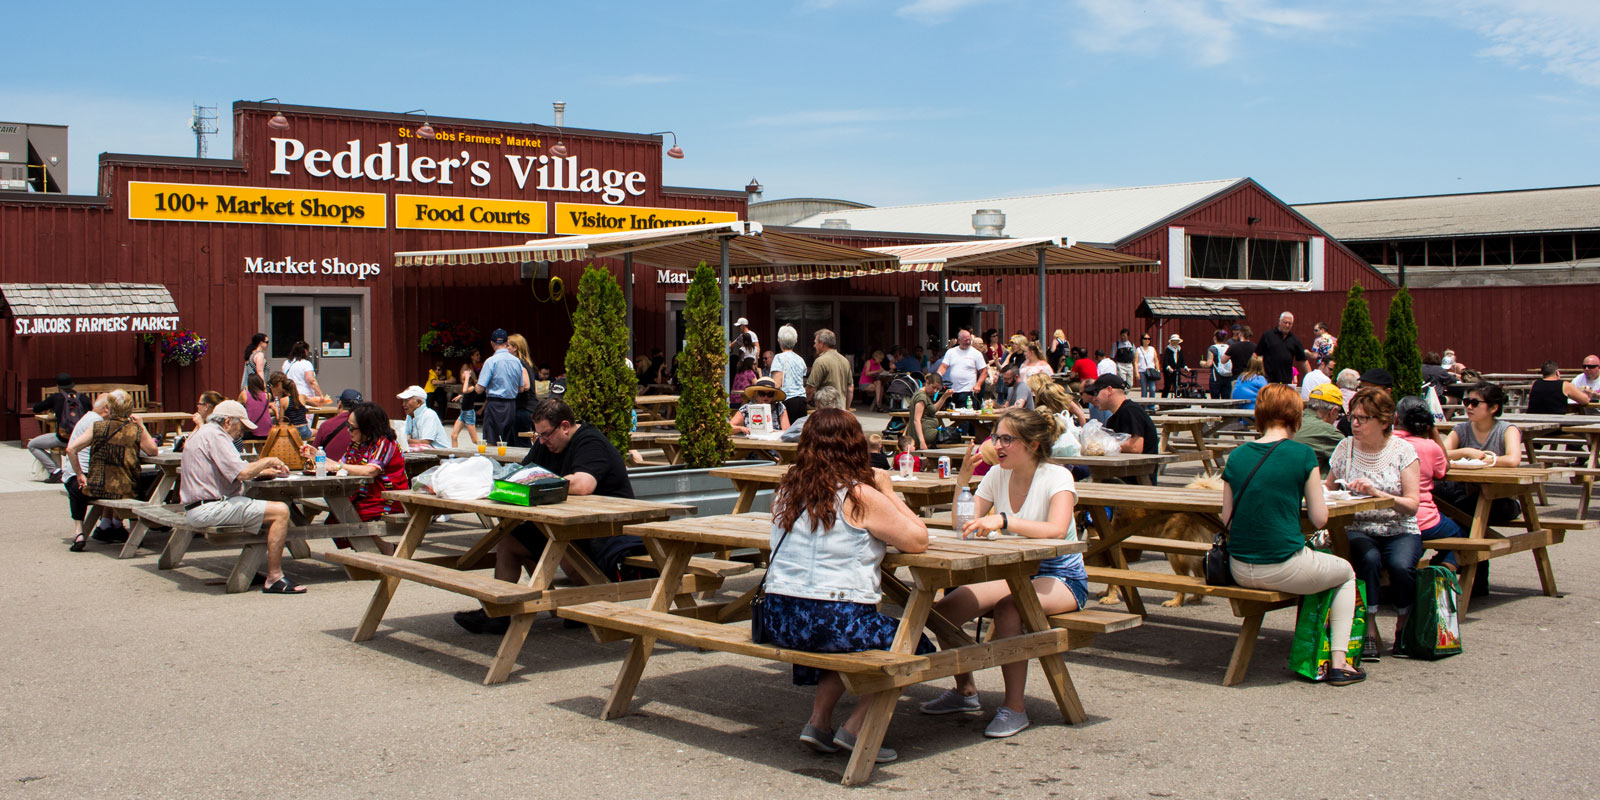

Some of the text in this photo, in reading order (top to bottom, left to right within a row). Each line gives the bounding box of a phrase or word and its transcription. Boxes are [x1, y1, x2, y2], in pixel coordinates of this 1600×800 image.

[0, 126, 18, 134] AIRE
[398, 127, 414, 138] St.
[415, 131, 456, 142] obs
[506, 136, 542, 148] Market
[504, 154, 647, 205] Village
[154, 192, 365, 224] 100+ Market Shops
[415, 204, 530, 226] Food Courts
[569, 211, 714, 229] Visitor Inform
[244, 256, 381, 280] Market Shops
[656, 269, 695, 284] Mark
[951, 280, 981, 292] Court
[131, 316, 179, 332] MARKET
